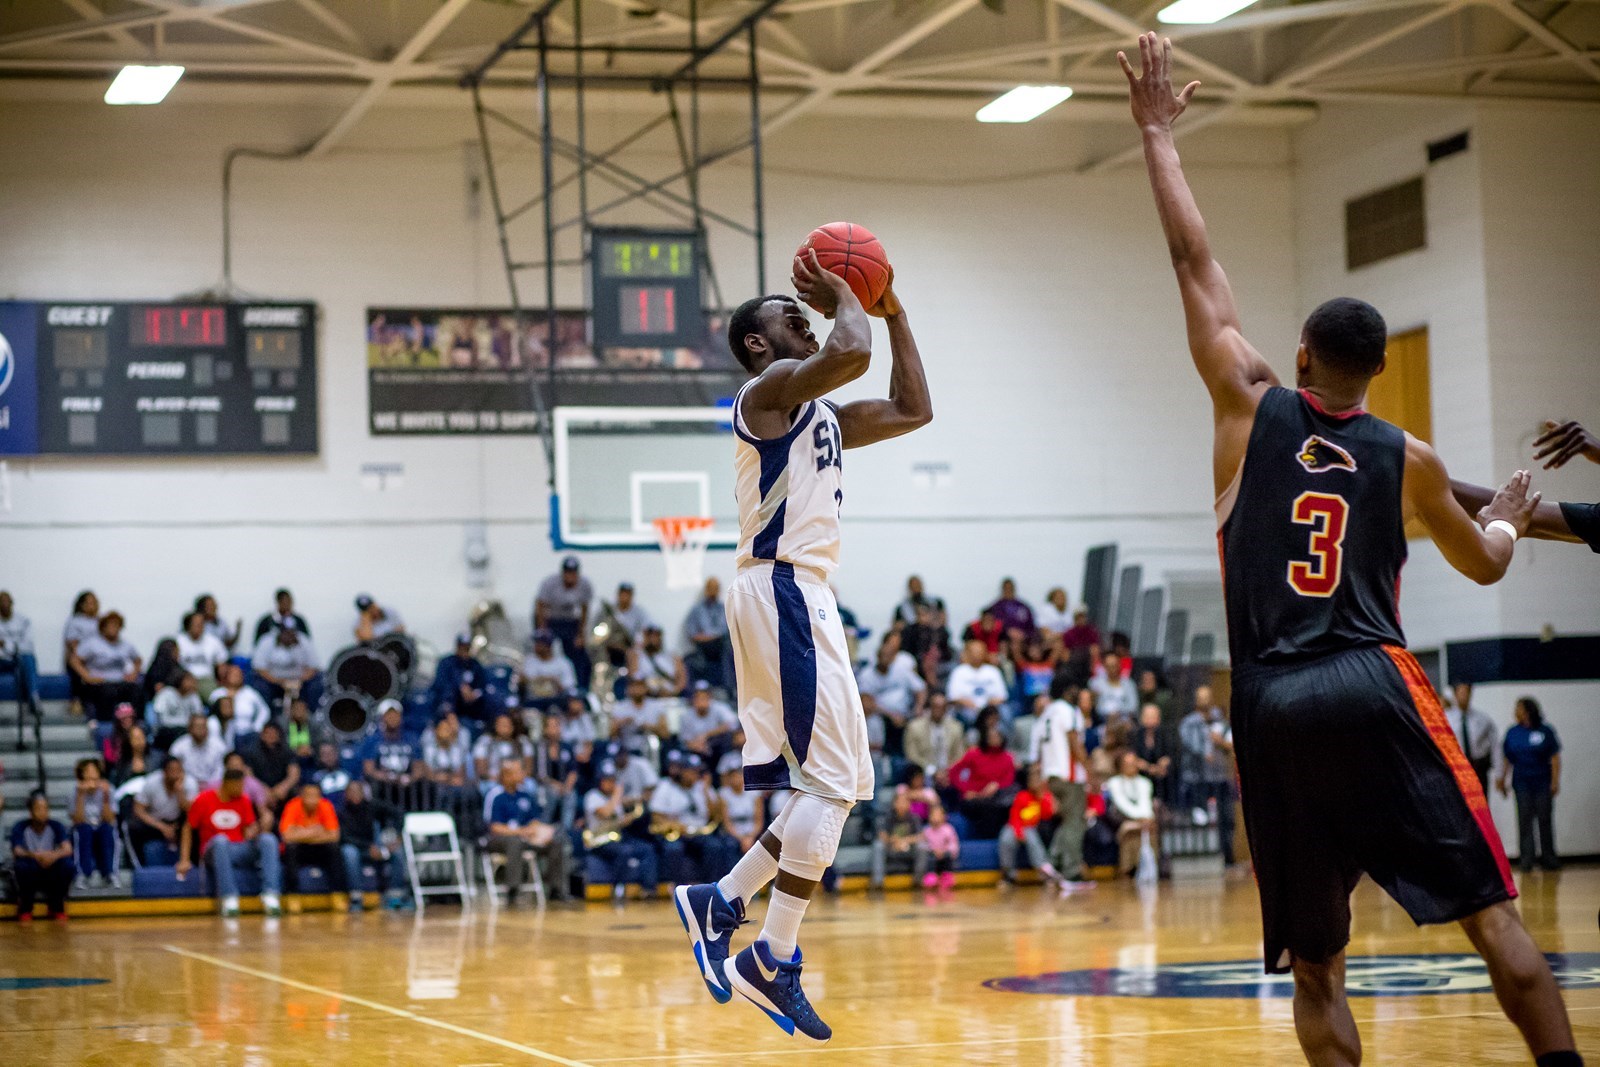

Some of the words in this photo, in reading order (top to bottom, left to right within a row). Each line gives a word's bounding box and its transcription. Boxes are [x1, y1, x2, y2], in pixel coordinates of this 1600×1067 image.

[48, 306, 113, 325] GUEST
[127, 361, 186, 379] PERIOD
[1287, 491, 1350, 598] 3
